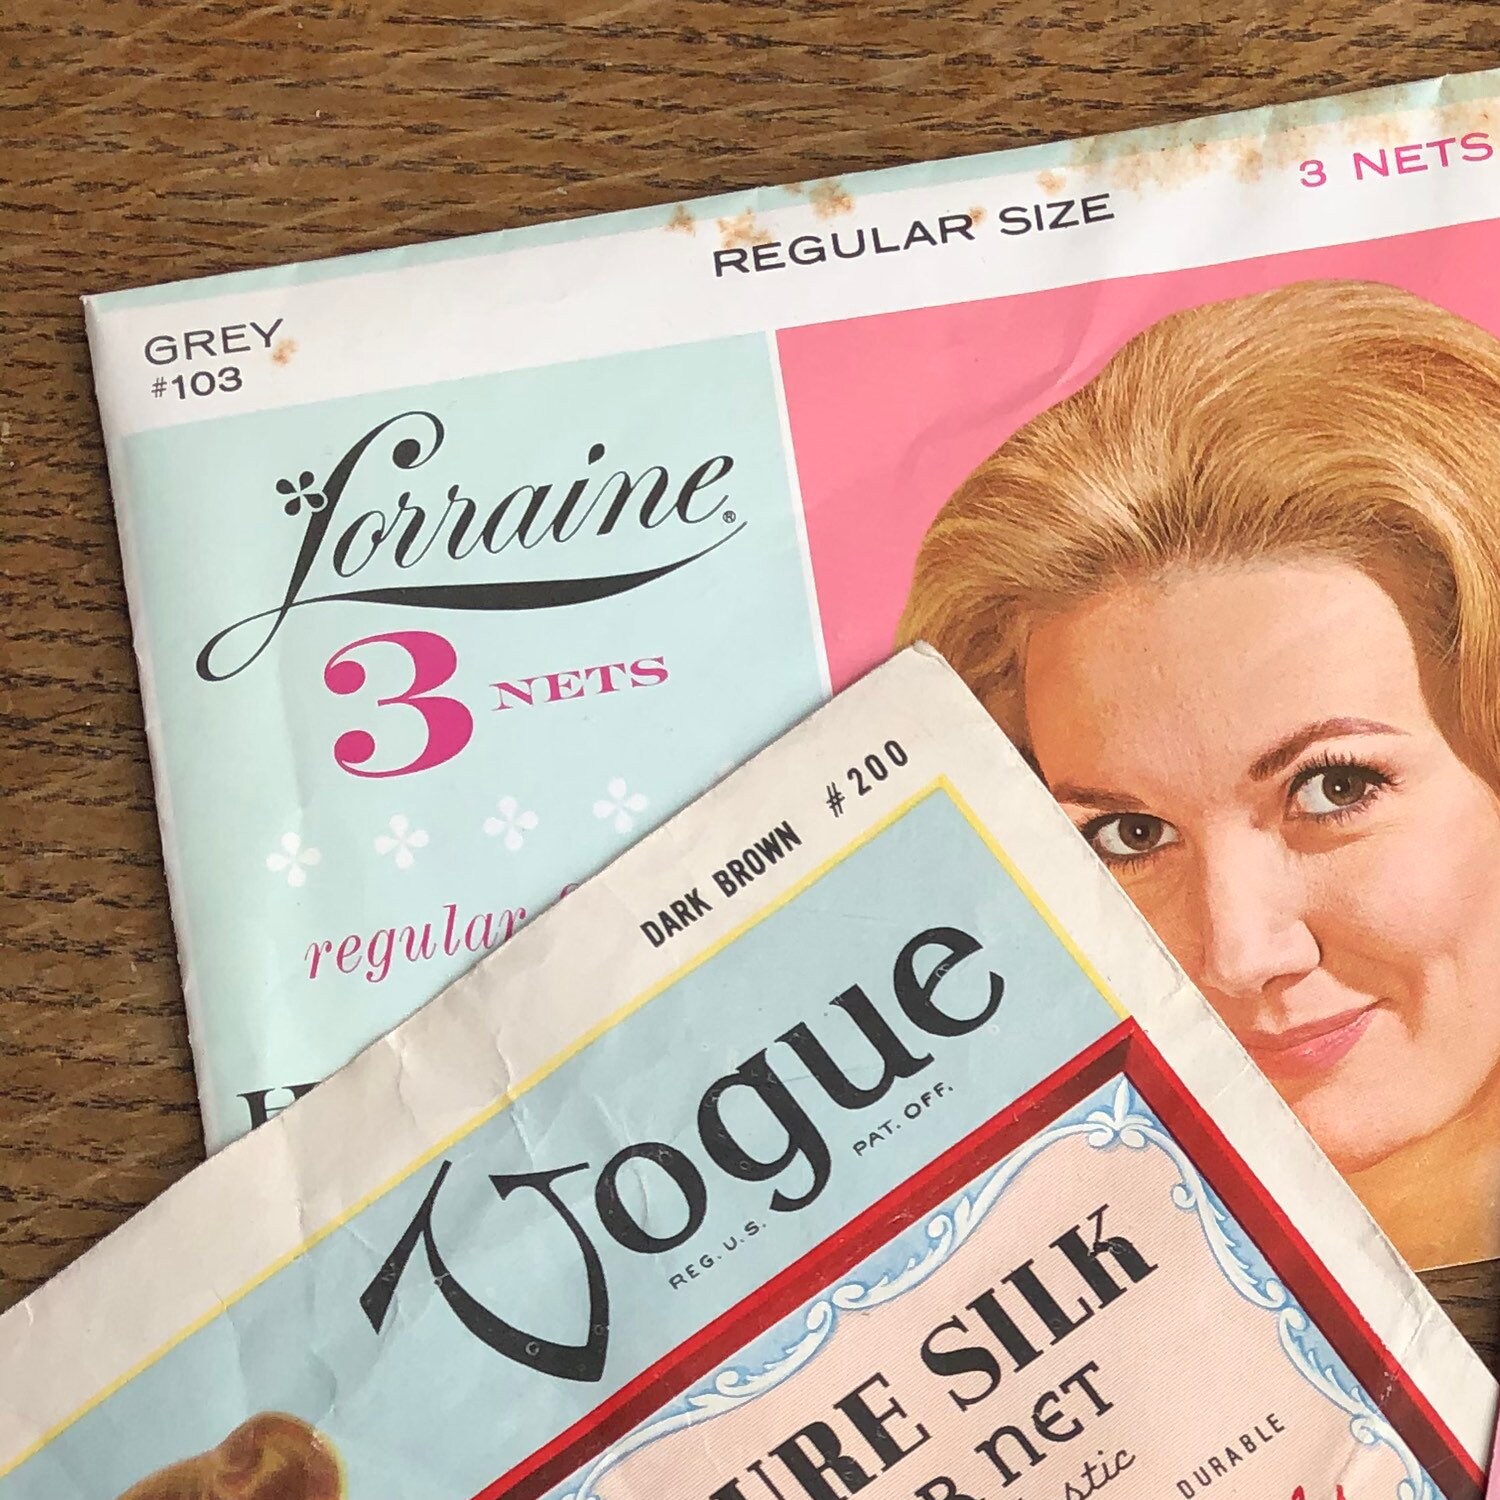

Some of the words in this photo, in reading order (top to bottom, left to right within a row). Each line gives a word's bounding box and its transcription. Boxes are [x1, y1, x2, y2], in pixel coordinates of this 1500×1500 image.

[1299, 160, 1328, 188] 3
[1353, 133, 1494, 180] NETS
[712, 213, 974, 279] REGULAR
[998, 193, 1115, 236] SIZE
[143, 318, 285, 367] GREY
[151, 370, 243, 401] #103
[323, 630, 474, 779] 3
[488, 656, 670, 712] NETS
[640, 887, 711, 949] DARK
[711, 820, 802, 901] BROWN
[304, 903, 527, 983] regular
[359, 926, 1005, 1382] Vogue
[668, 1254, 722, 1289] REG.
[852, 1119, 902, 1156] PAT.
[903, 1082, 954, 1119] OFF.
[920, 1203, 1159, 1412] SILK
[1176, 1412, 1288, 1500] DURABLE
